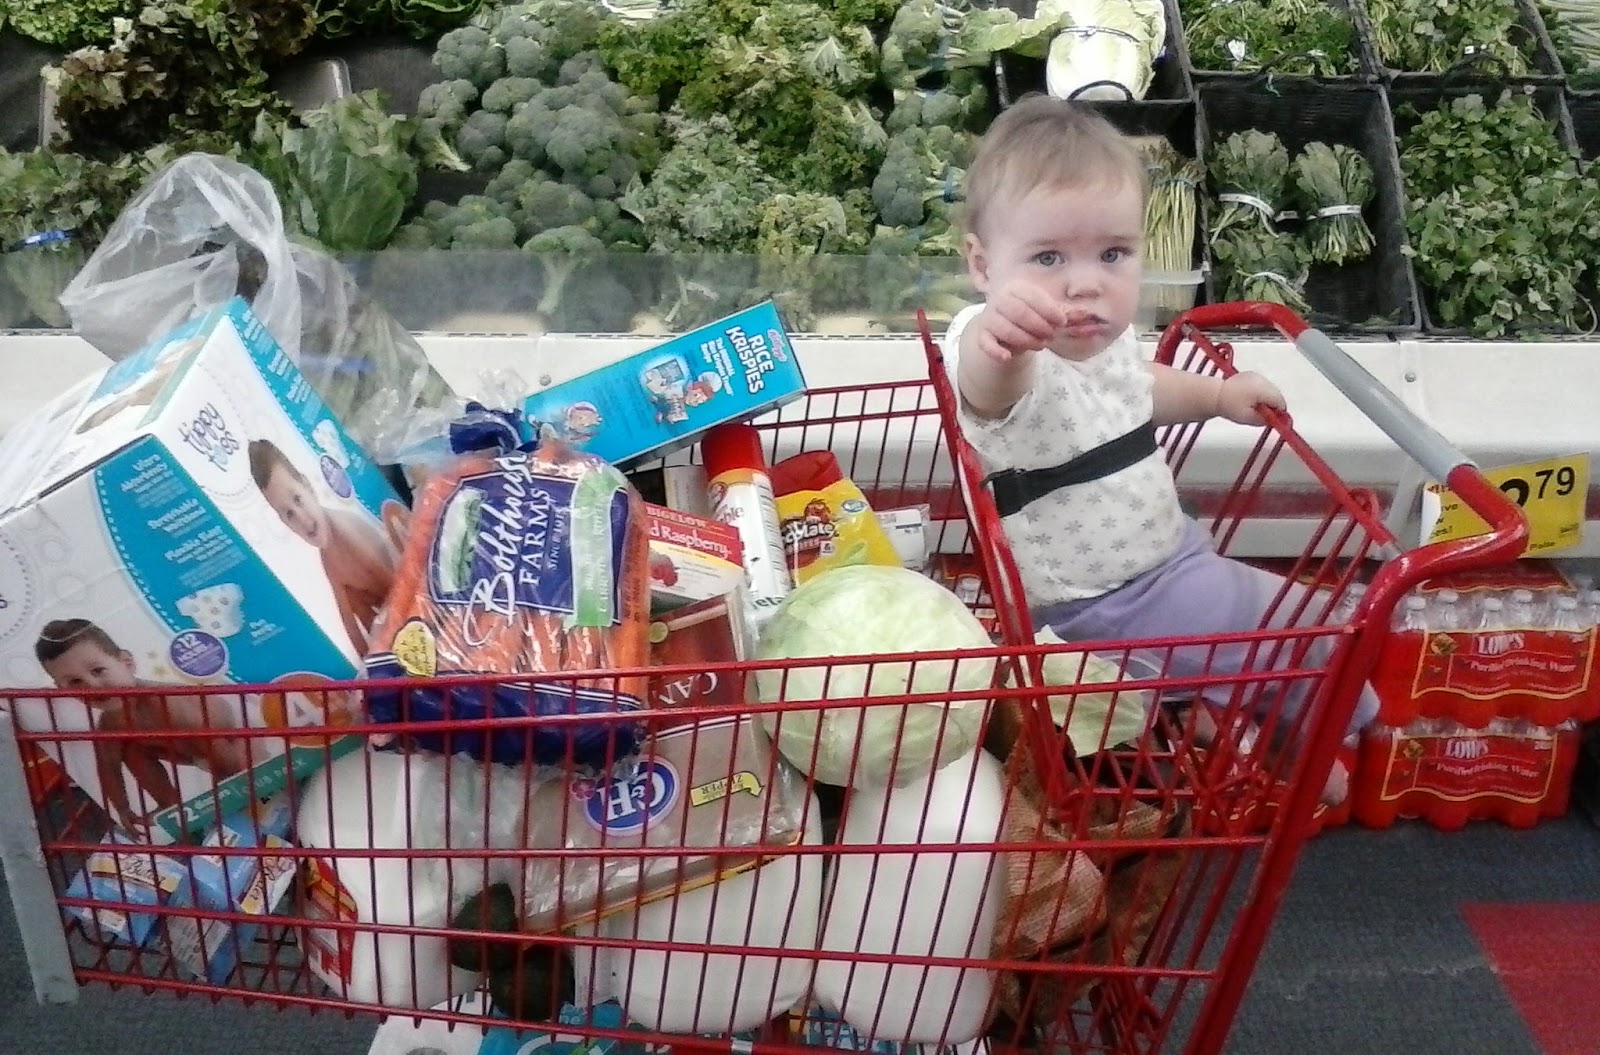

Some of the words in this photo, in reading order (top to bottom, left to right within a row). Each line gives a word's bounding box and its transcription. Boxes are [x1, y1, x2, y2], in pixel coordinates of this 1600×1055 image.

[725, 325, 765, 394] KRISPIES
[747, 334, 776, 374] RICE
[178, 402, 226, 455] tippy
[1534, 466, 1576, 500] 79
[645, 505, 707, 528] BIGELOW
[518, 487, 552, 587] FARMS
[661, 525, 733, 560] Raspberry
[1549, 660, 1577, 673] Water
[1511, 764, 1540, 778] Water
[596, 770, 667, 823] C&H
